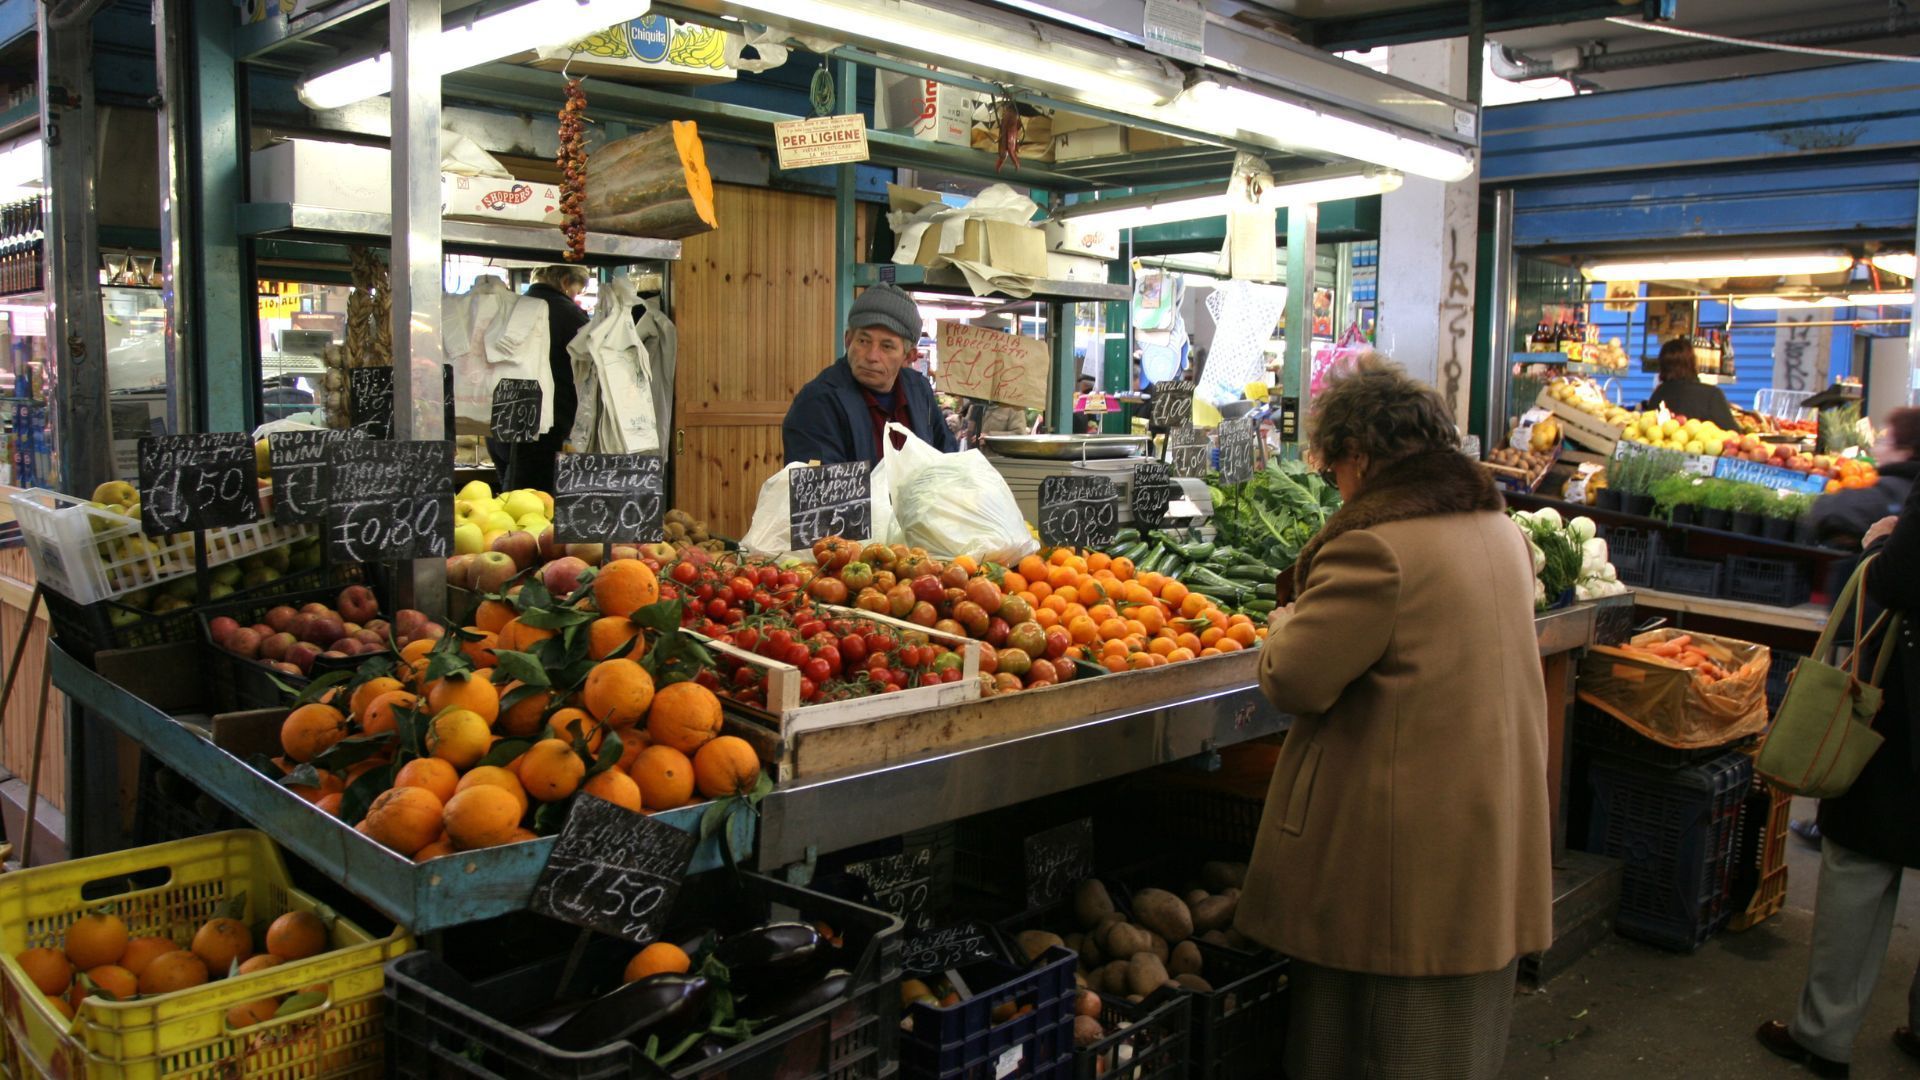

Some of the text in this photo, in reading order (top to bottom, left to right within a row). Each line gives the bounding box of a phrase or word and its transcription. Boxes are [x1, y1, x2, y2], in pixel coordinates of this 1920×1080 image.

[631, 26, 666, 45] Chiquita
[783, 129, 861, 147] PER L'IGIENE
[482, 186, 532, 207] SHOPPERS
[1718, 462, 1793, 489] Marlene
